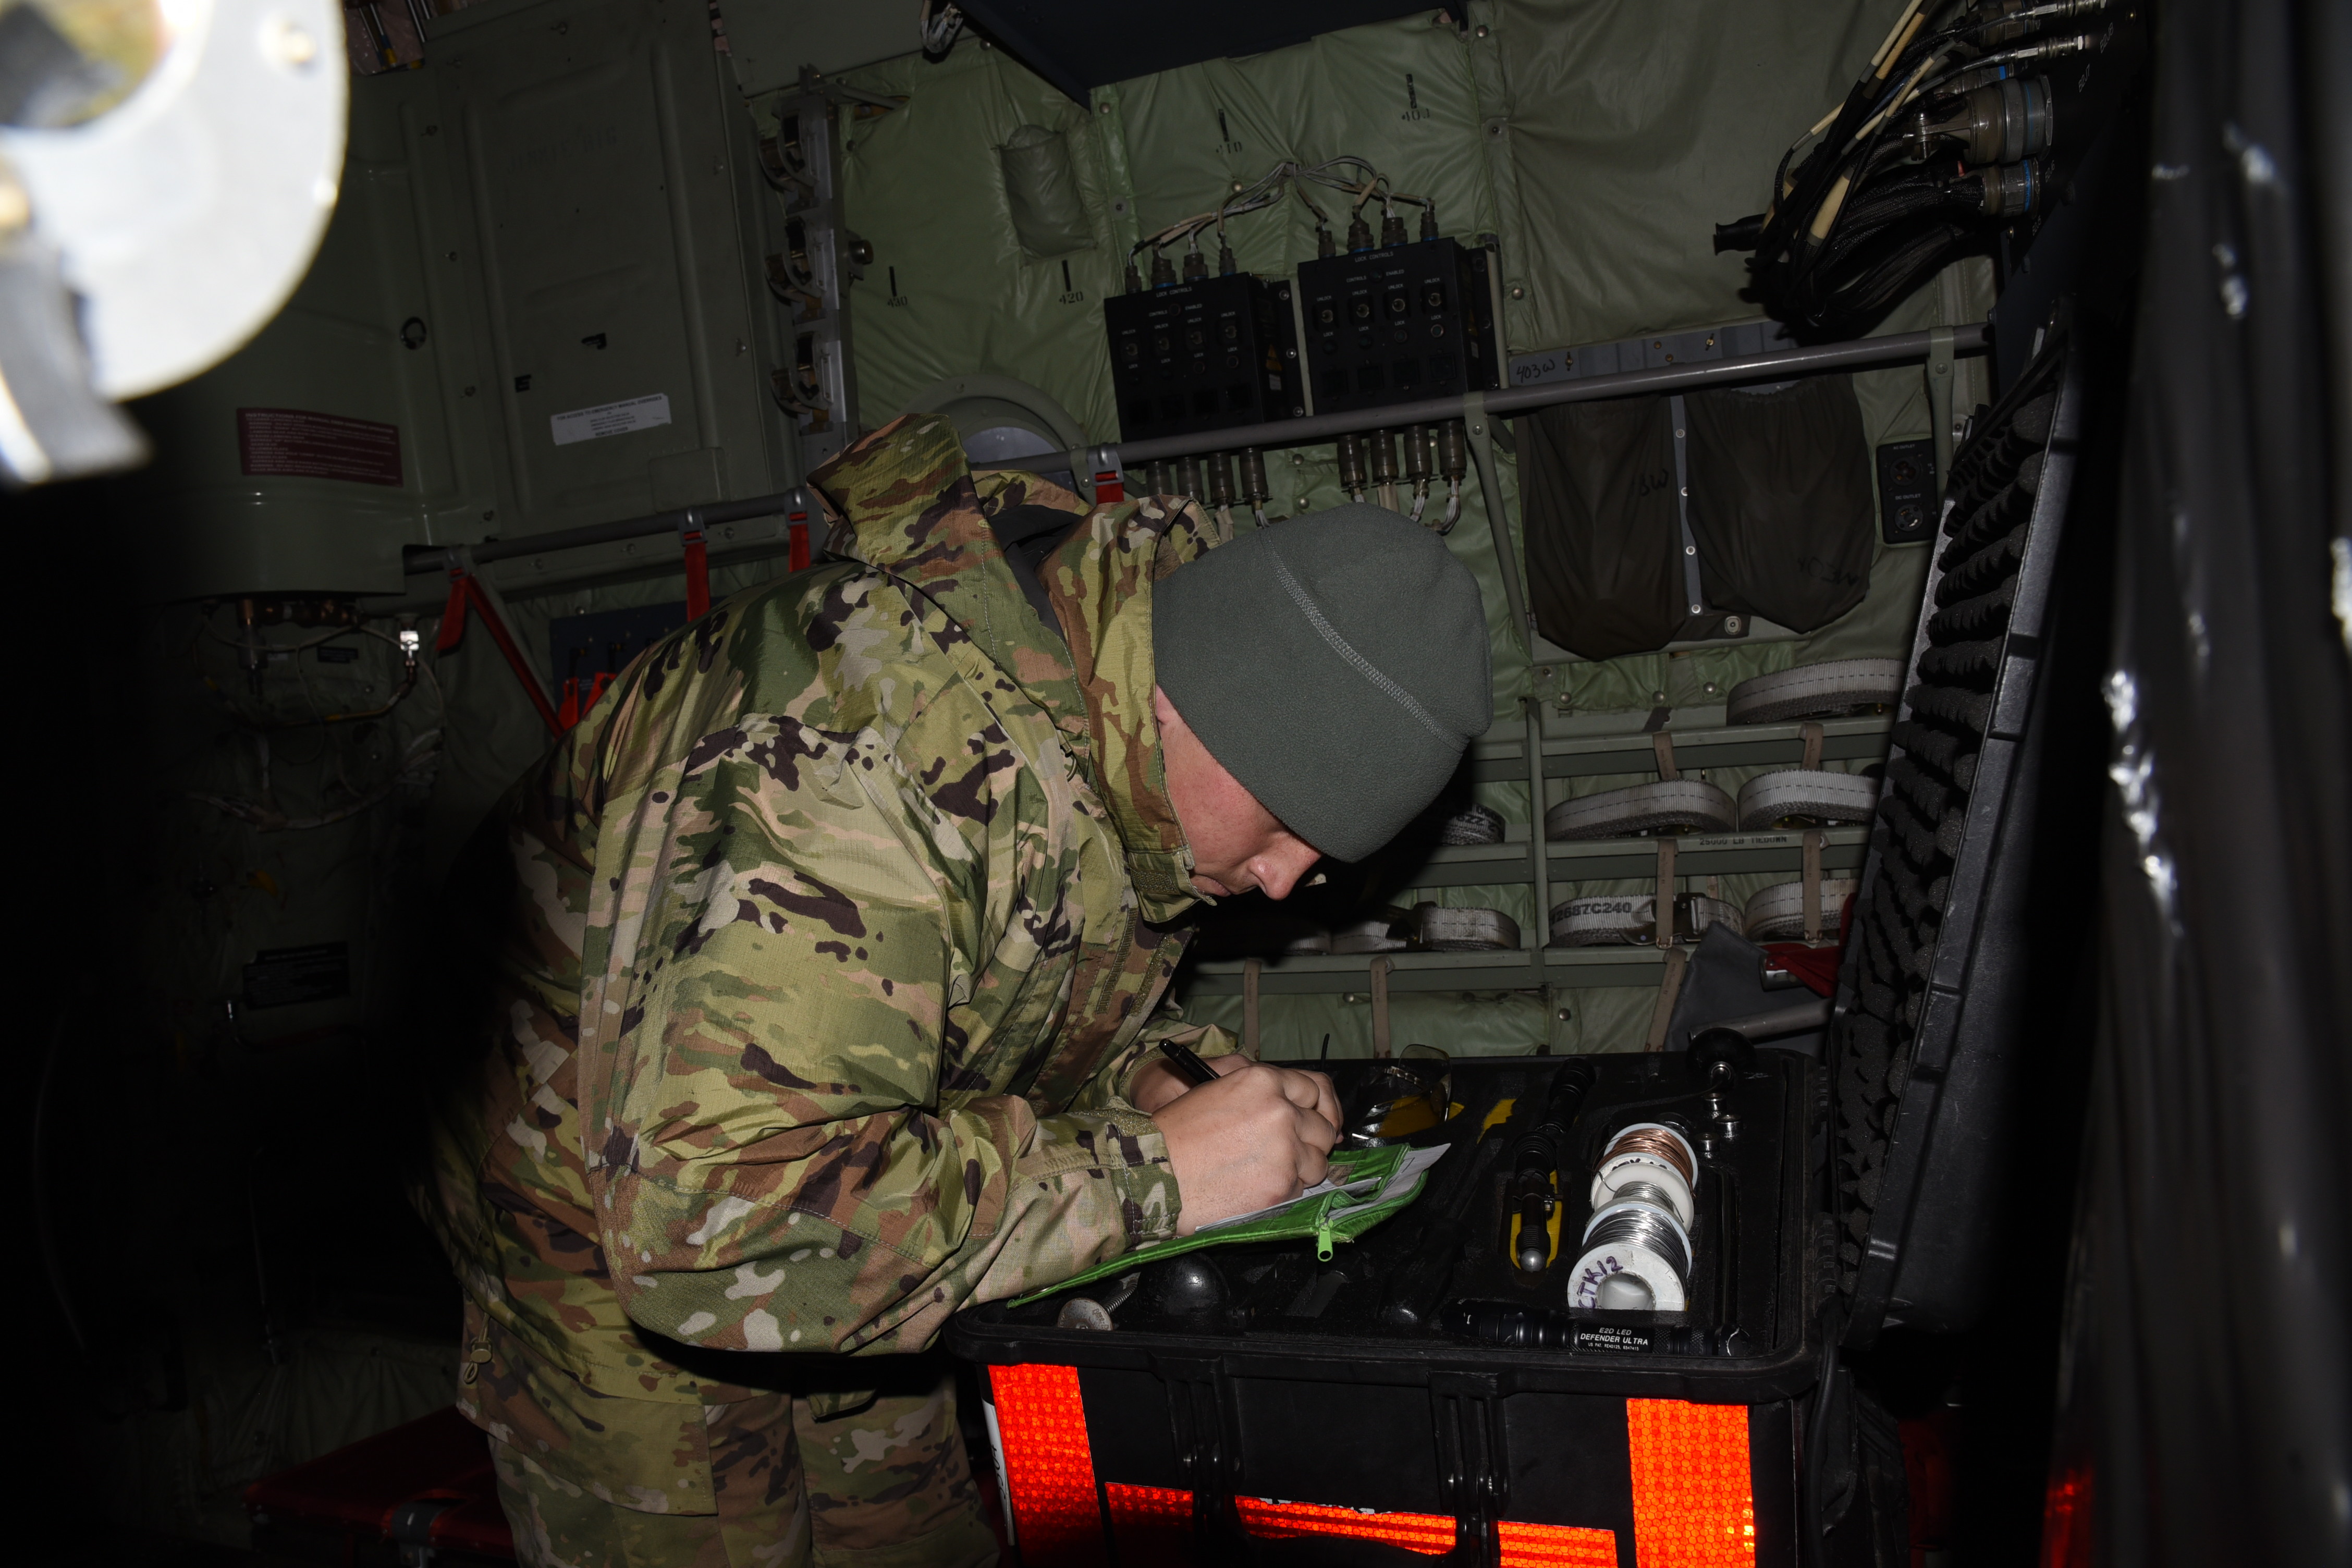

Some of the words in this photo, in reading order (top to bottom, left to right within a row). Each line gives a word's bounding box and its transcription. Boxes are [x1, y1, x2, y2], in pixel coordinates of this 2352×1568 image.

[2100, 22, 2114, 54] B2J8
[2078, 63, 2090, 93] B2J7
[1369, 251, 1393, 261] CONTROLS
[1170, 286, 1192, 295] CONTROLS
[887, 296, 908, 308] 430
[1059, 291, 1084, 304] 420
[1580, 1333, 1620, 1343] DEFENDER
